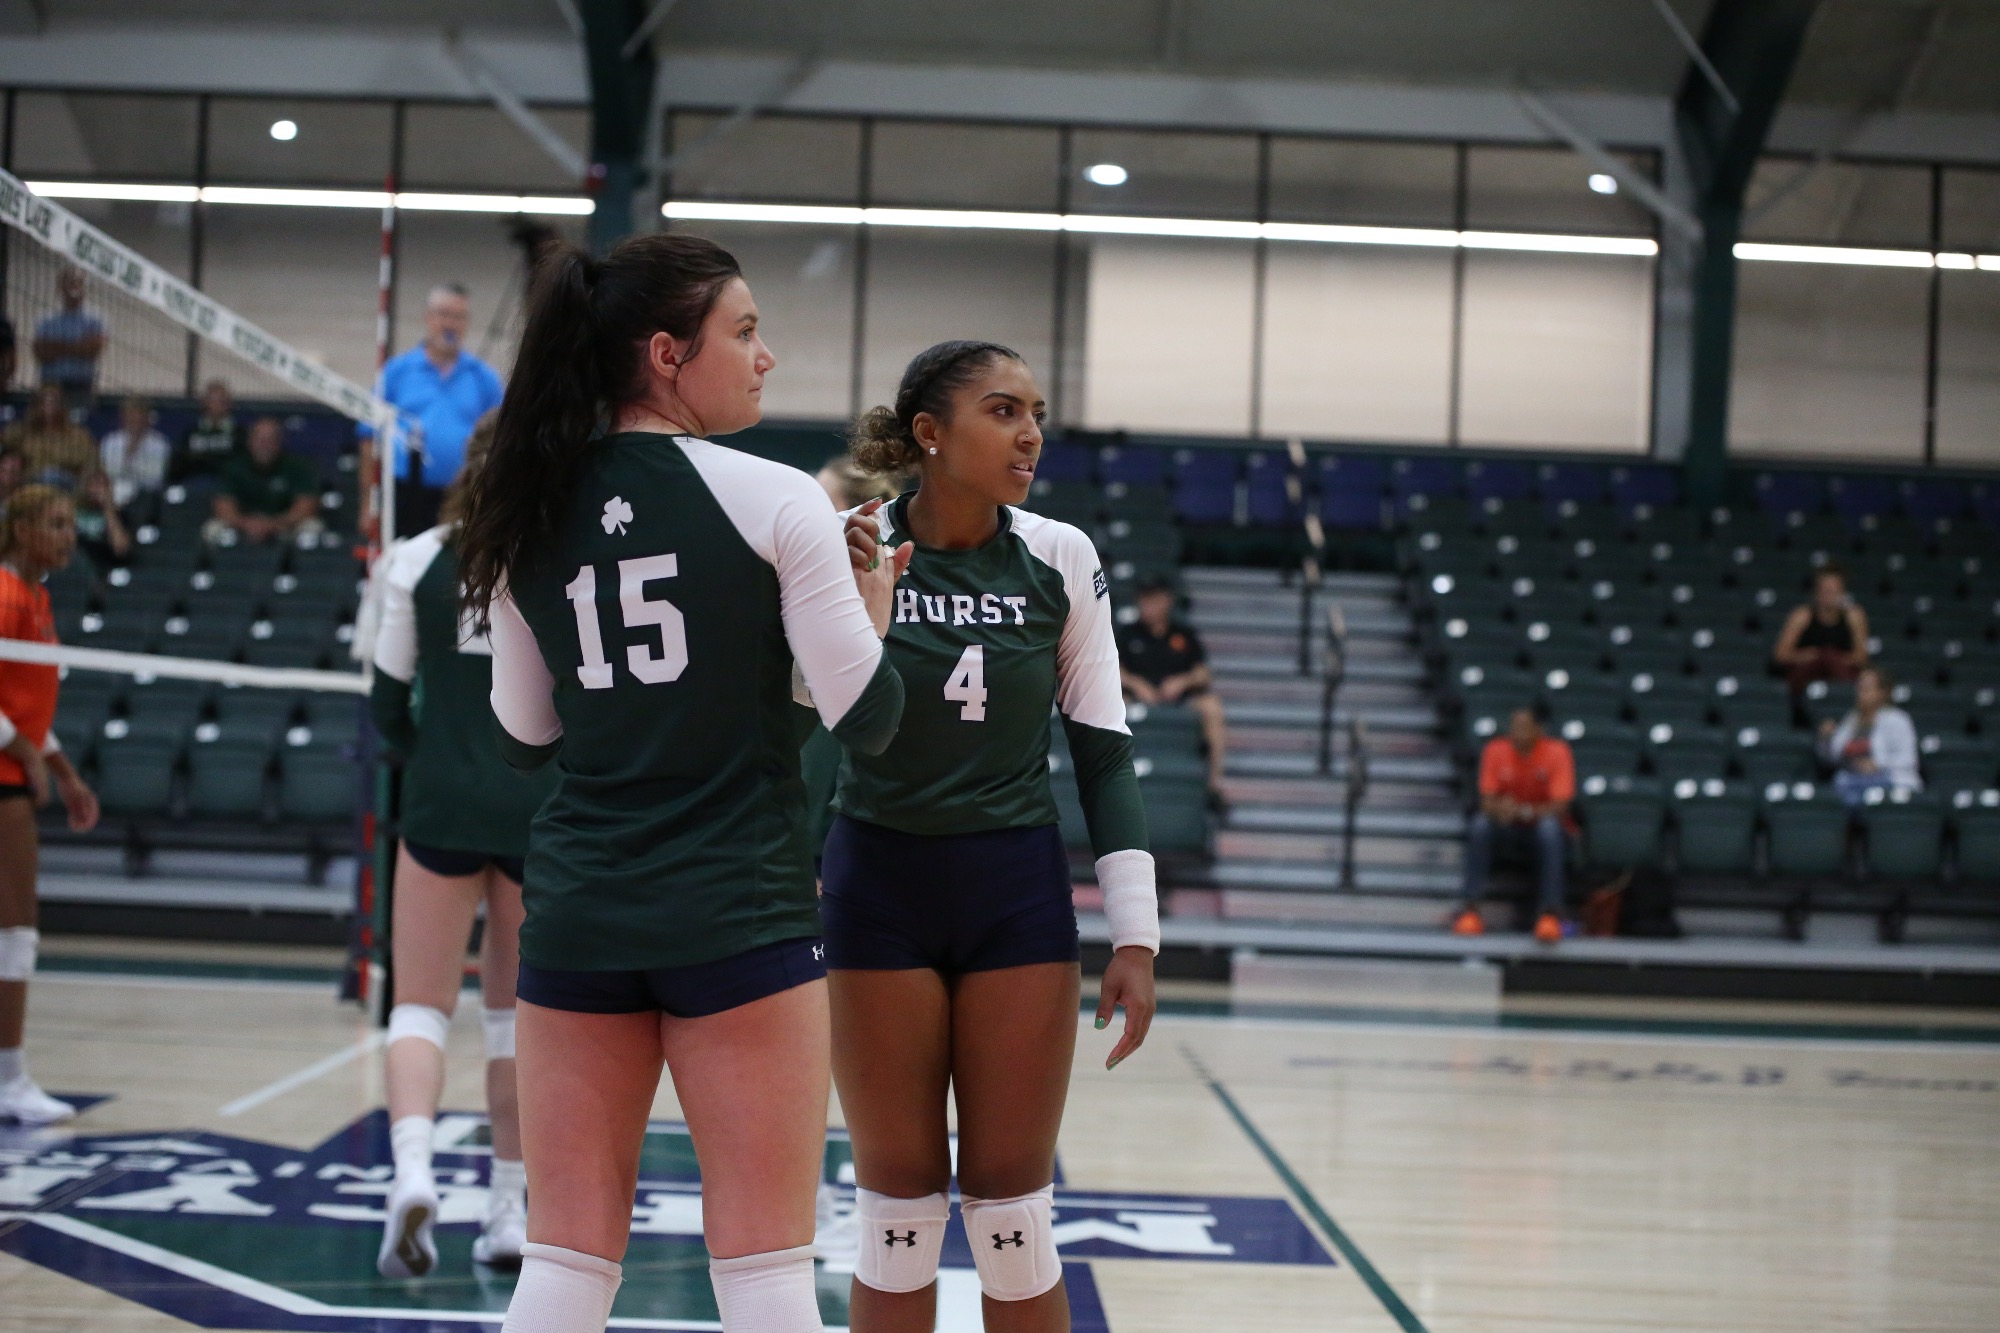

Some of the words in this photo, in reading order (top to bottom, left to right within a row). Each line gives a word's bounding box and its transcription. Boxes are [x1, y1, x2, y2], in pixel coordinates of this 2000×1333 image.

[565, 552, 689, 689] 15
[894, 587, 1027, 627] HURST
[943, 644, 988, 722] 4
